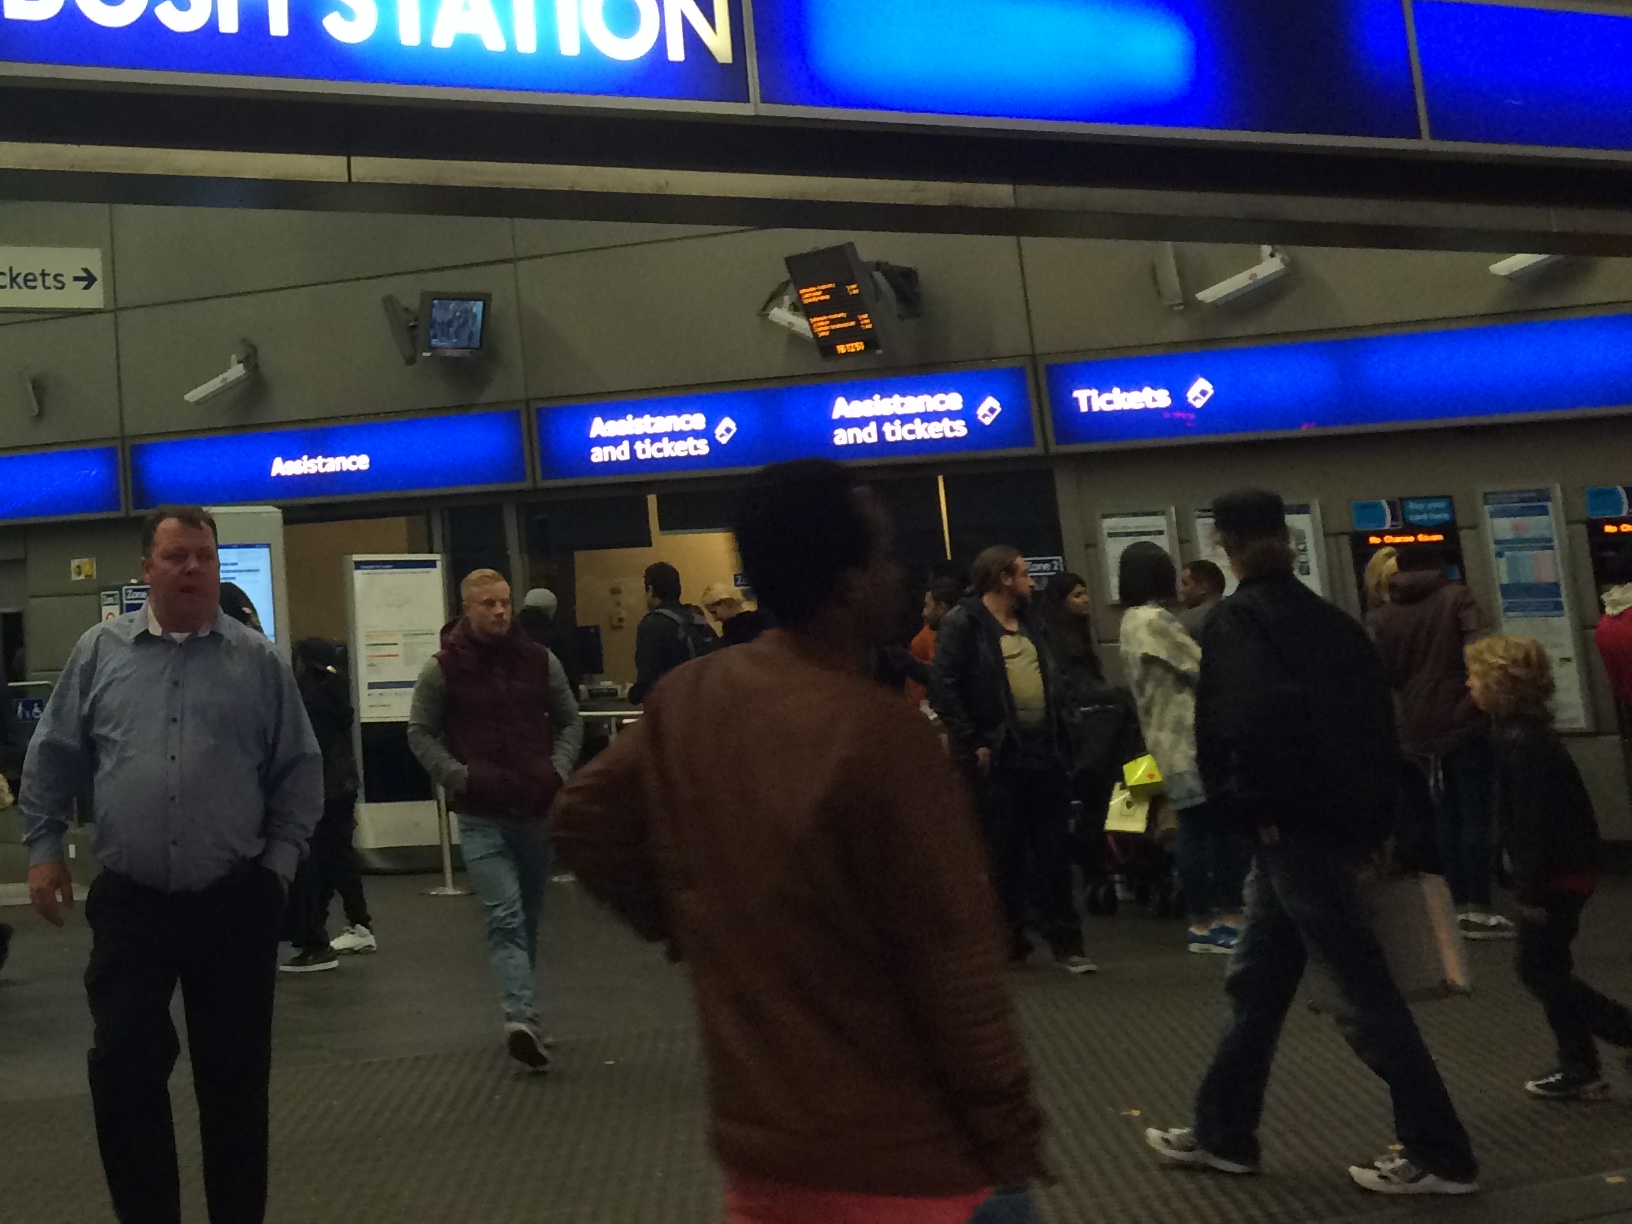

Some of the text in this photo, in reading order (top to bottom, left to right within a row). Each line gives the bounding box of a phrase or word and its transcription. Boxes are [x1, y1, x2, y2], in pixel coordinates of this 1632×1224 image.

[831, 392, 964, 420] Assistance
[1072, 386, 1172, 413] Tickets
[589, 412, 707, 439] Assistance
[833, 417, 968, 446] and tickets
[590, 436, 710, 463] and tickets
[270, 454, 370, 477] Assistance
